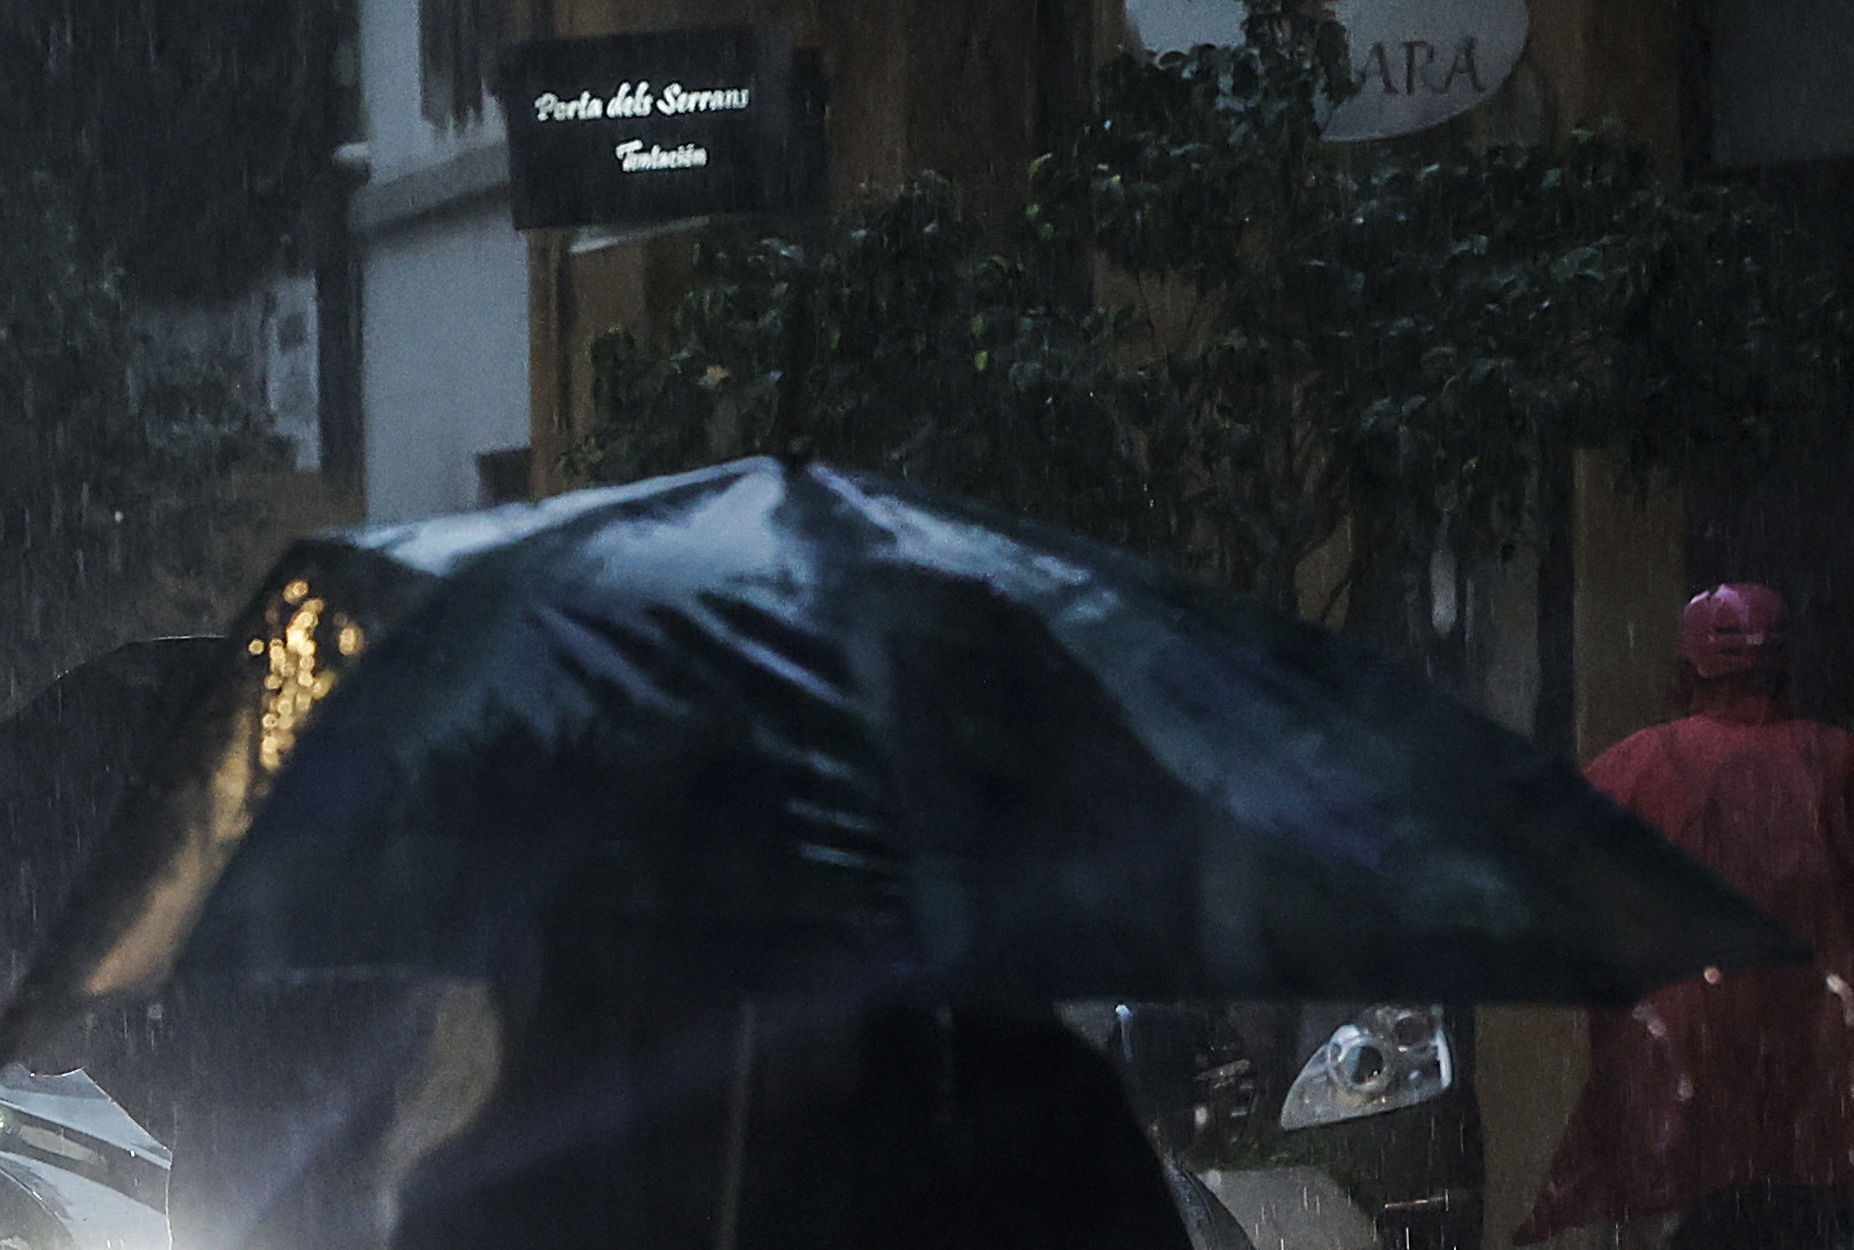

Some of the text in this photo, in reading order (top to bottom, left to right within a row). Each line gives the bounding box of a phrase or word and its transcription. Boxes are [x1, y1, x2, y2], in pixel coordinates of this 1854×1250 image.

[1349, 36, 1487, 97] ARA
[534, 81, 749, 121] Porta dels Serrans
